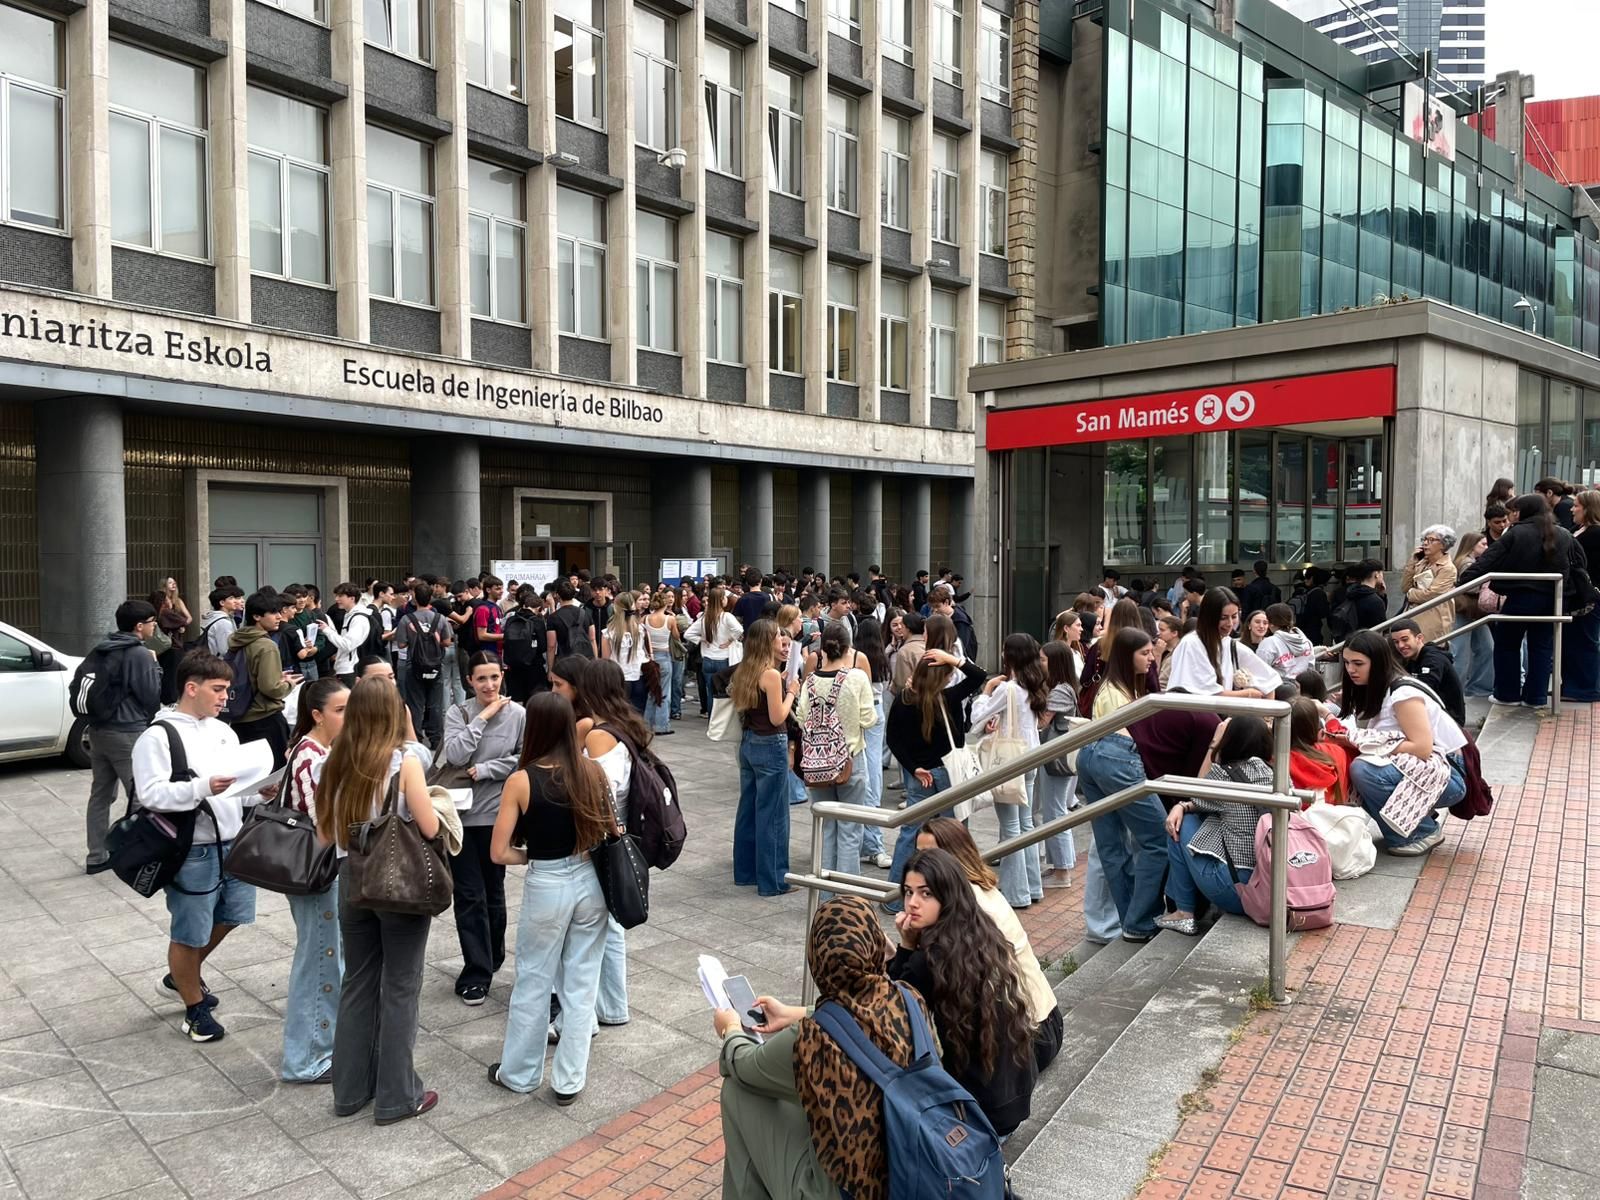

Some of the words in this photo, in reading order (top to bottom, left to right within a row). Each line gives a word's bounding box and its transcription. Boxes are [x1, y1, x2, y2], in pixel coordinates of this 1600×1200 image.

[1, 309, 154, 356] niaritza
[164, 330, 273, 373] Eskola
[343, 358, 435, 394] Escuela
[441, 373, 469, 398] de
[476, 377, 577, 413] Ingeniería
[582, 393, 605, 416] de
[610, 397, 663, 423] Bilbao
[1076, 412, 1111, 433] San
[1118, 401, 1189, 429] Mamés
